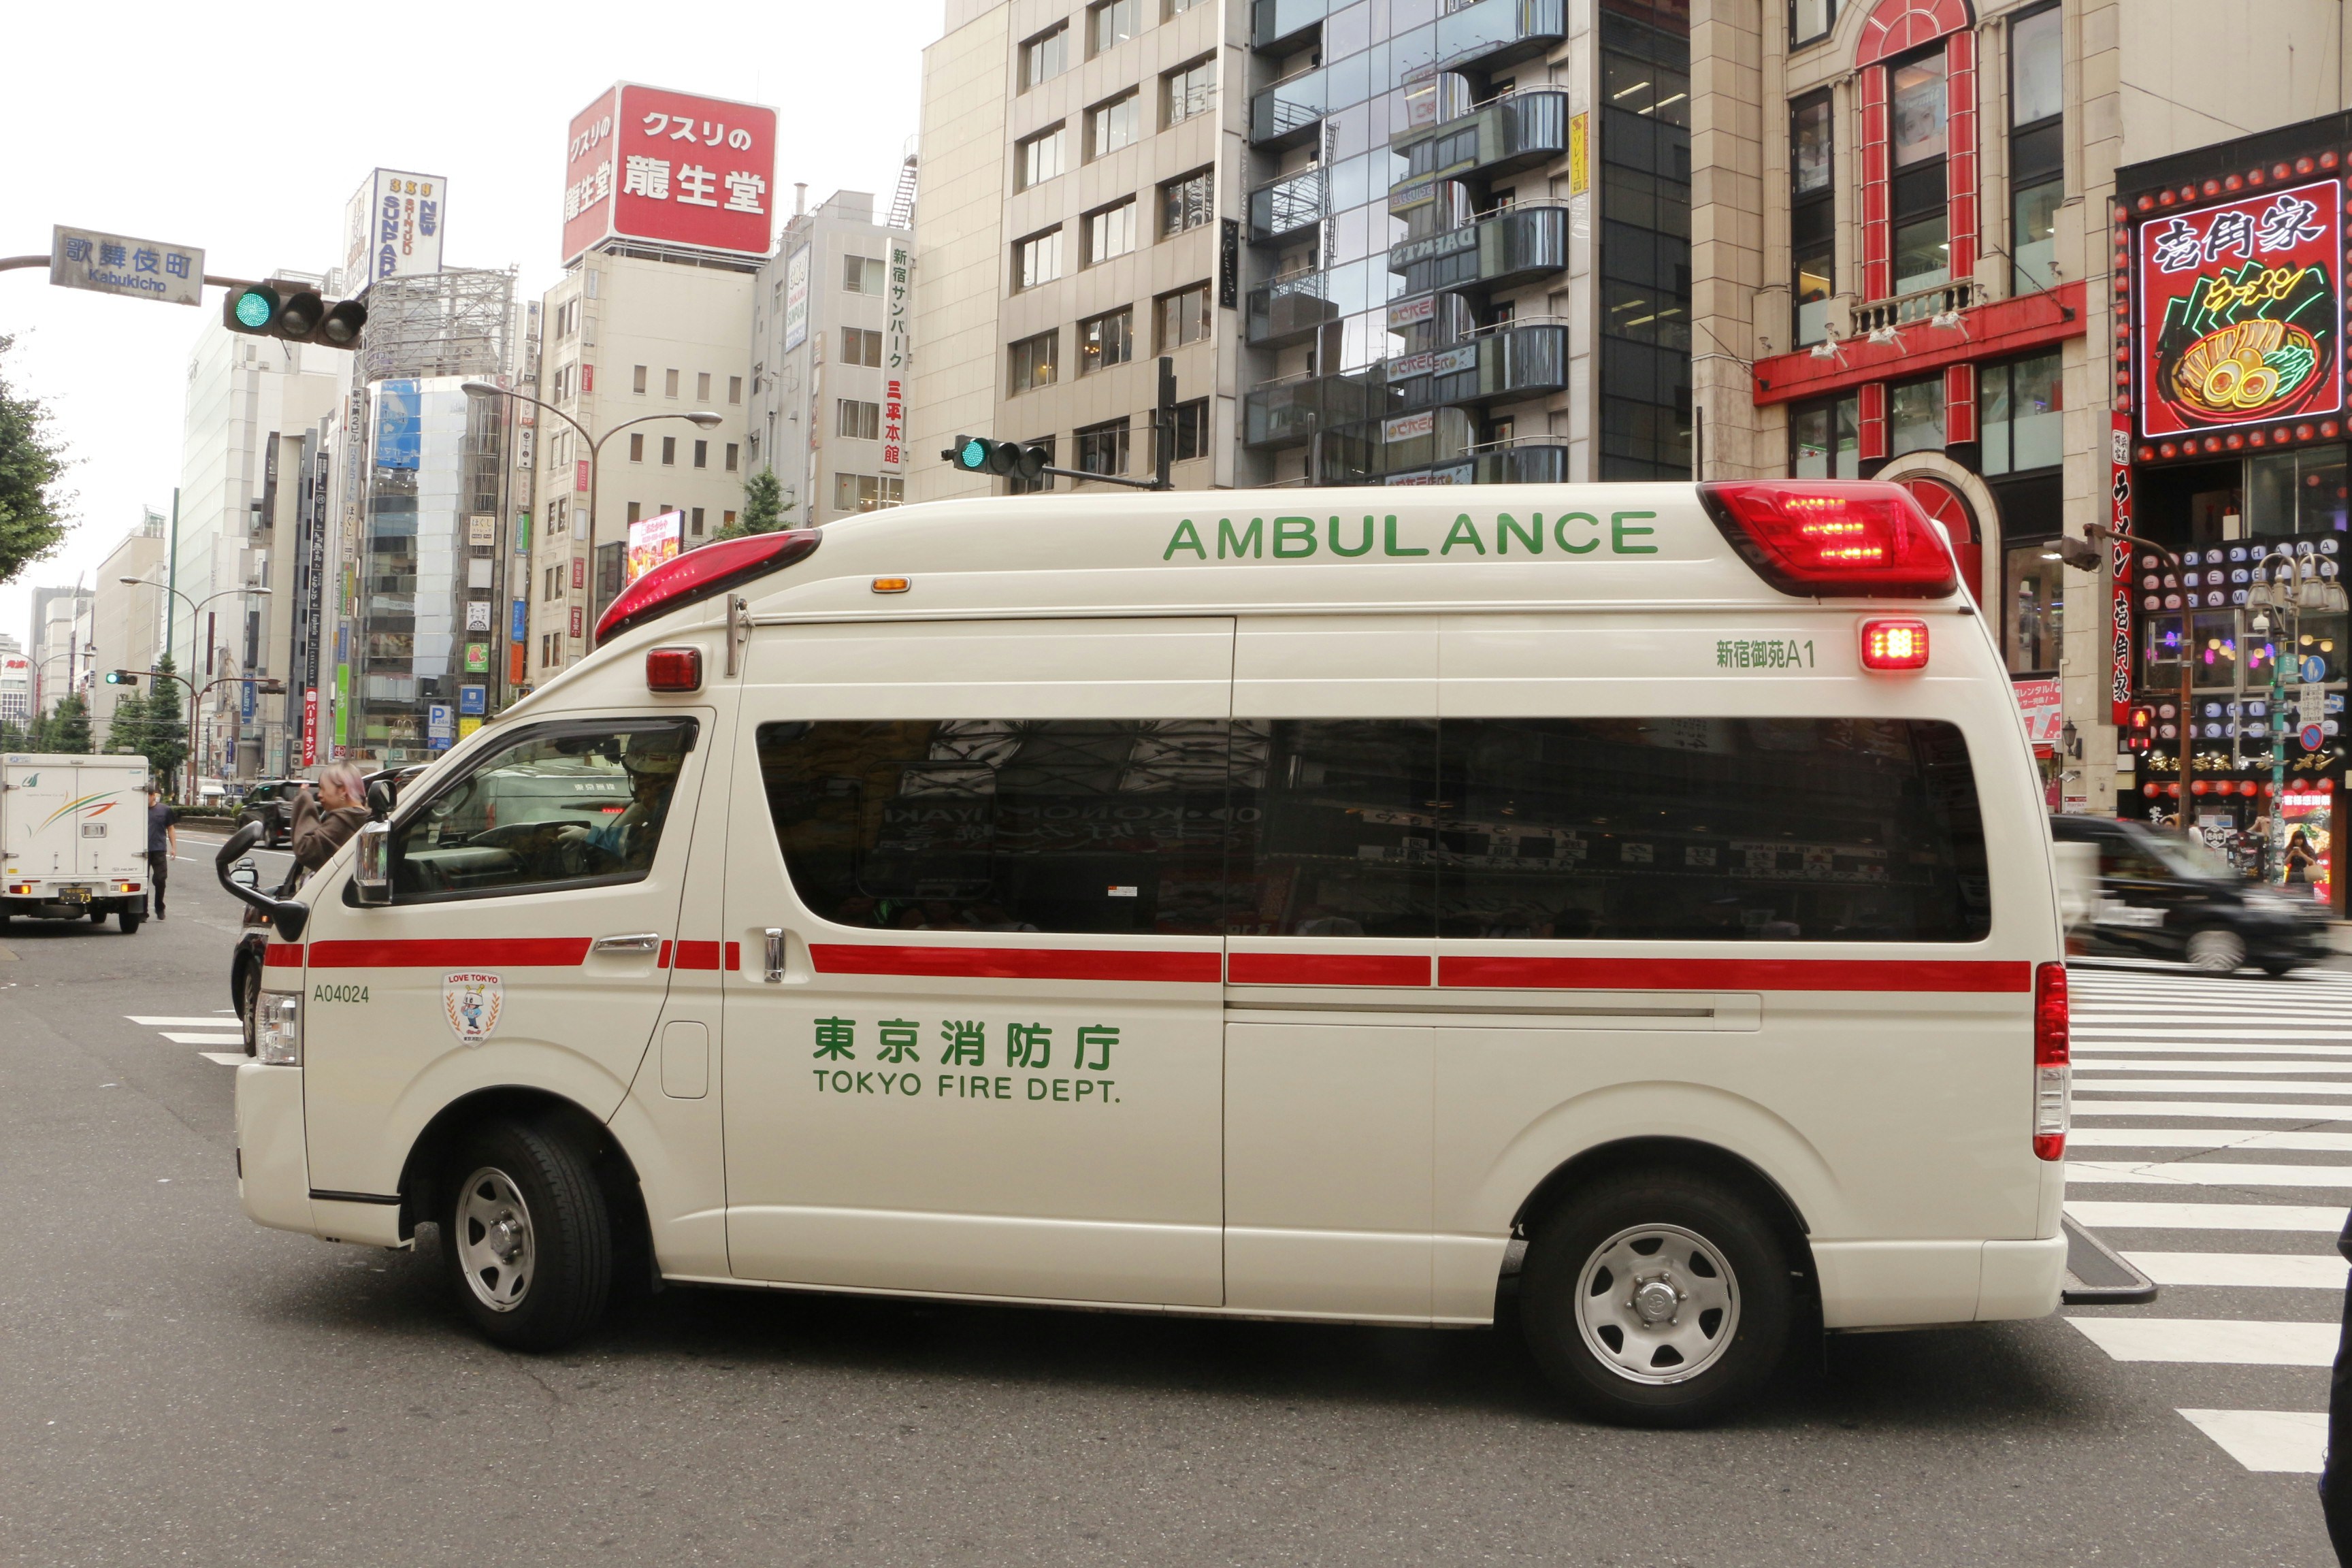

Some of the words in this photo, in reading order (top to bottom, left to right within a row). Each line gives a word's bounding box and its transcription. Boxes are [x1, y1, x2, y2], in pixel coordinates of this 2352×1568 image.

[570, 116, 611, 163] クスリの
[642, 112, 751, 150] クスリの
[564, 161, 610, 223] 龍生堂
[623, 155, 765, 214] 龍生堂
[379, 196, 400, 278] SUNPARK
[402, 199, 414, 255] SHINJUKU
[419, 200, 437, 237] NEW
[2154, 195, 2326, 273] 壱角家
[66, 238, 191, 278] 歌舞伎町
[88, 268, 166, 292] Kabukicho
[889, 248, 907, 368] 新宿サンパーク
[2204, 267, 2305, 312] ラーメン
[350, 390, 361, 442] 新光第2ビル
[884, 380, 902, 464] 三平本館
[348, 448, 358, 492] パステルコート
[472, 519, 492, 527] ほぐし
[1163, 511, 1659, 560] AMBULANCE
[2112, 470, 2130, 577] ラーメン
[1716, 640, 1814, 668] 新宿御苑A1
[306, 704, 316, 760] バーガーキング
[431, 708, 445, 723] P
[2282, 795, 2331, 806] 客様感謝祭
[80, 893, 91, 902] 73
[314, 984, 370, 1004] A04024
[448, 975, 469, 983] LOVE
[470, 974, 498, 984] TOKYO
[813, 1016, 1120, 1071] 東京消防庁
[813, 1070, 921, 1096] TOKYO
[938, 1075, 1012, 1099] FIRE
[1028, 1078, 1120, 1103] DEPT.
